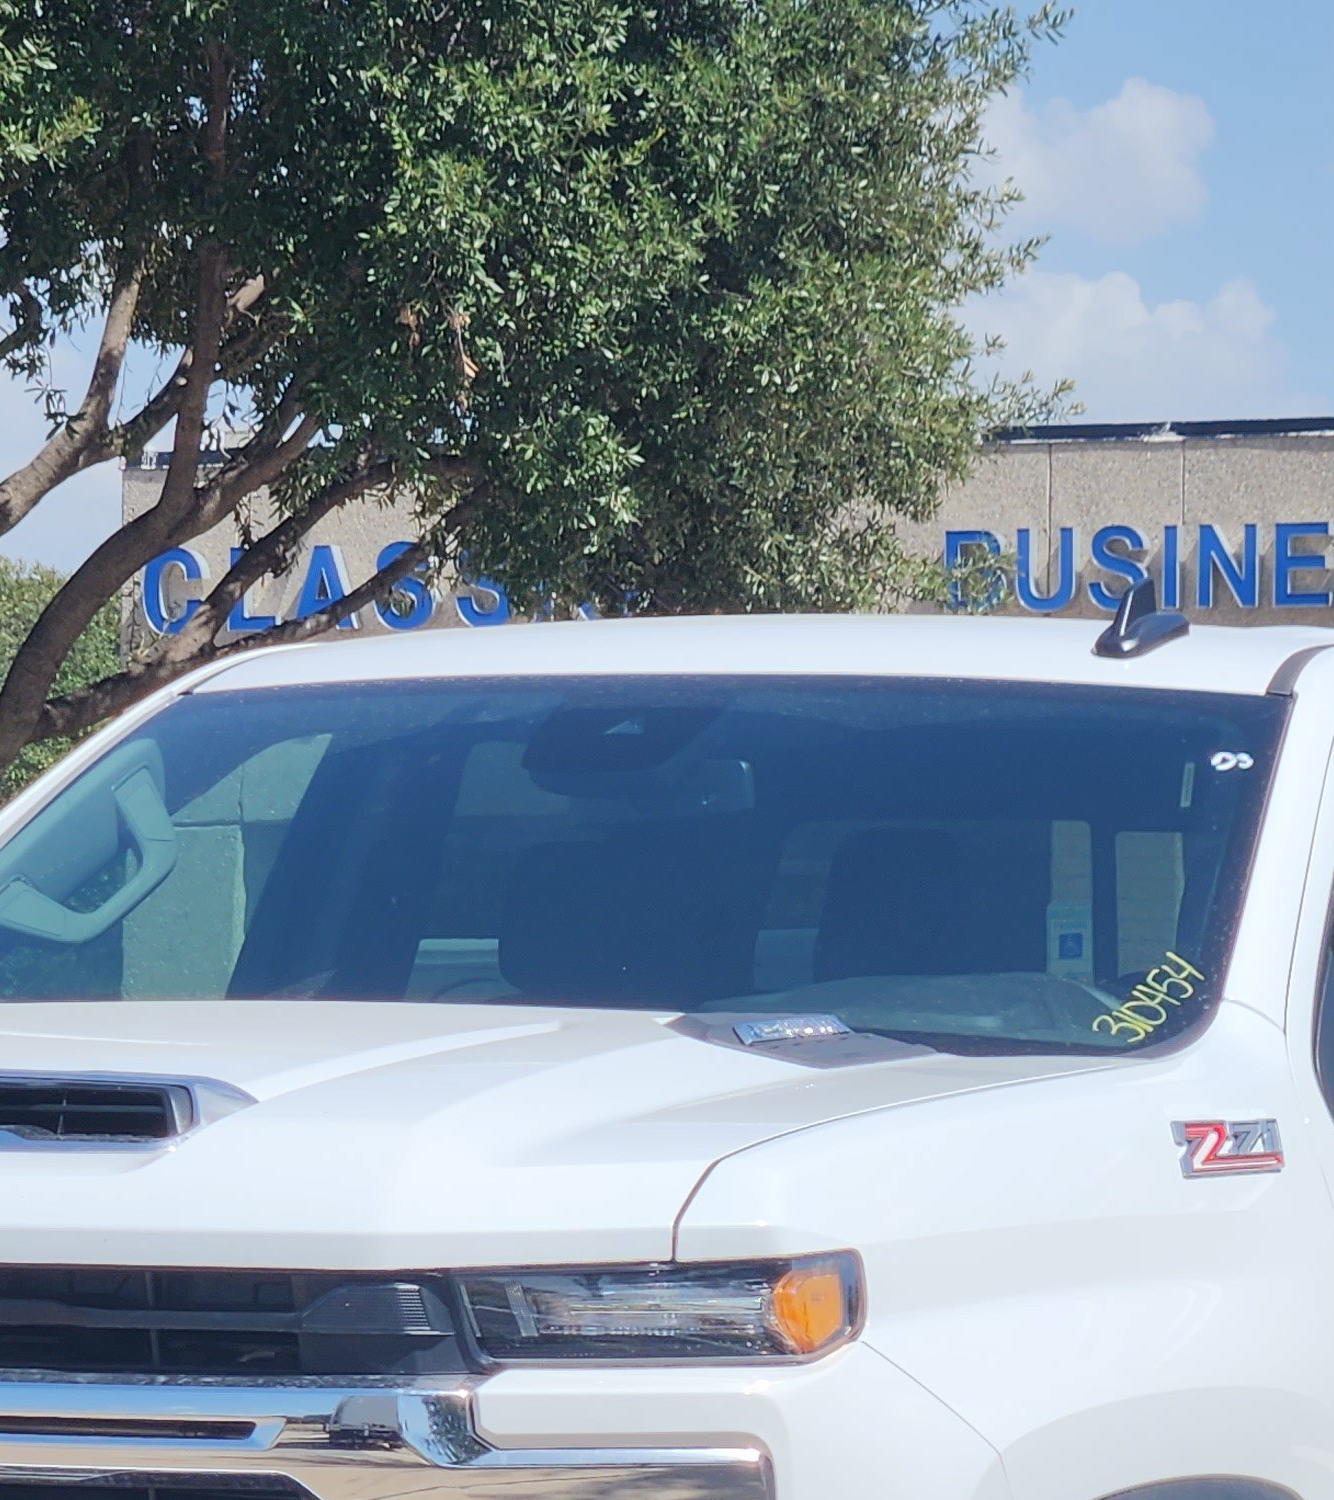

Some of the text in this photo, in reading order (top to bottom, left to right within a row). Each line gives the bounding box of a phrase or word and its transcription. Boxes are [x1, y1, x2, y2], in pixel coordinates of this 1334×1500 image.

[142, 540, 635, 634] CLASS
[1091, 951, 1205, 1043] 310454
[1170, 1118, 1285, 1179] Z71
